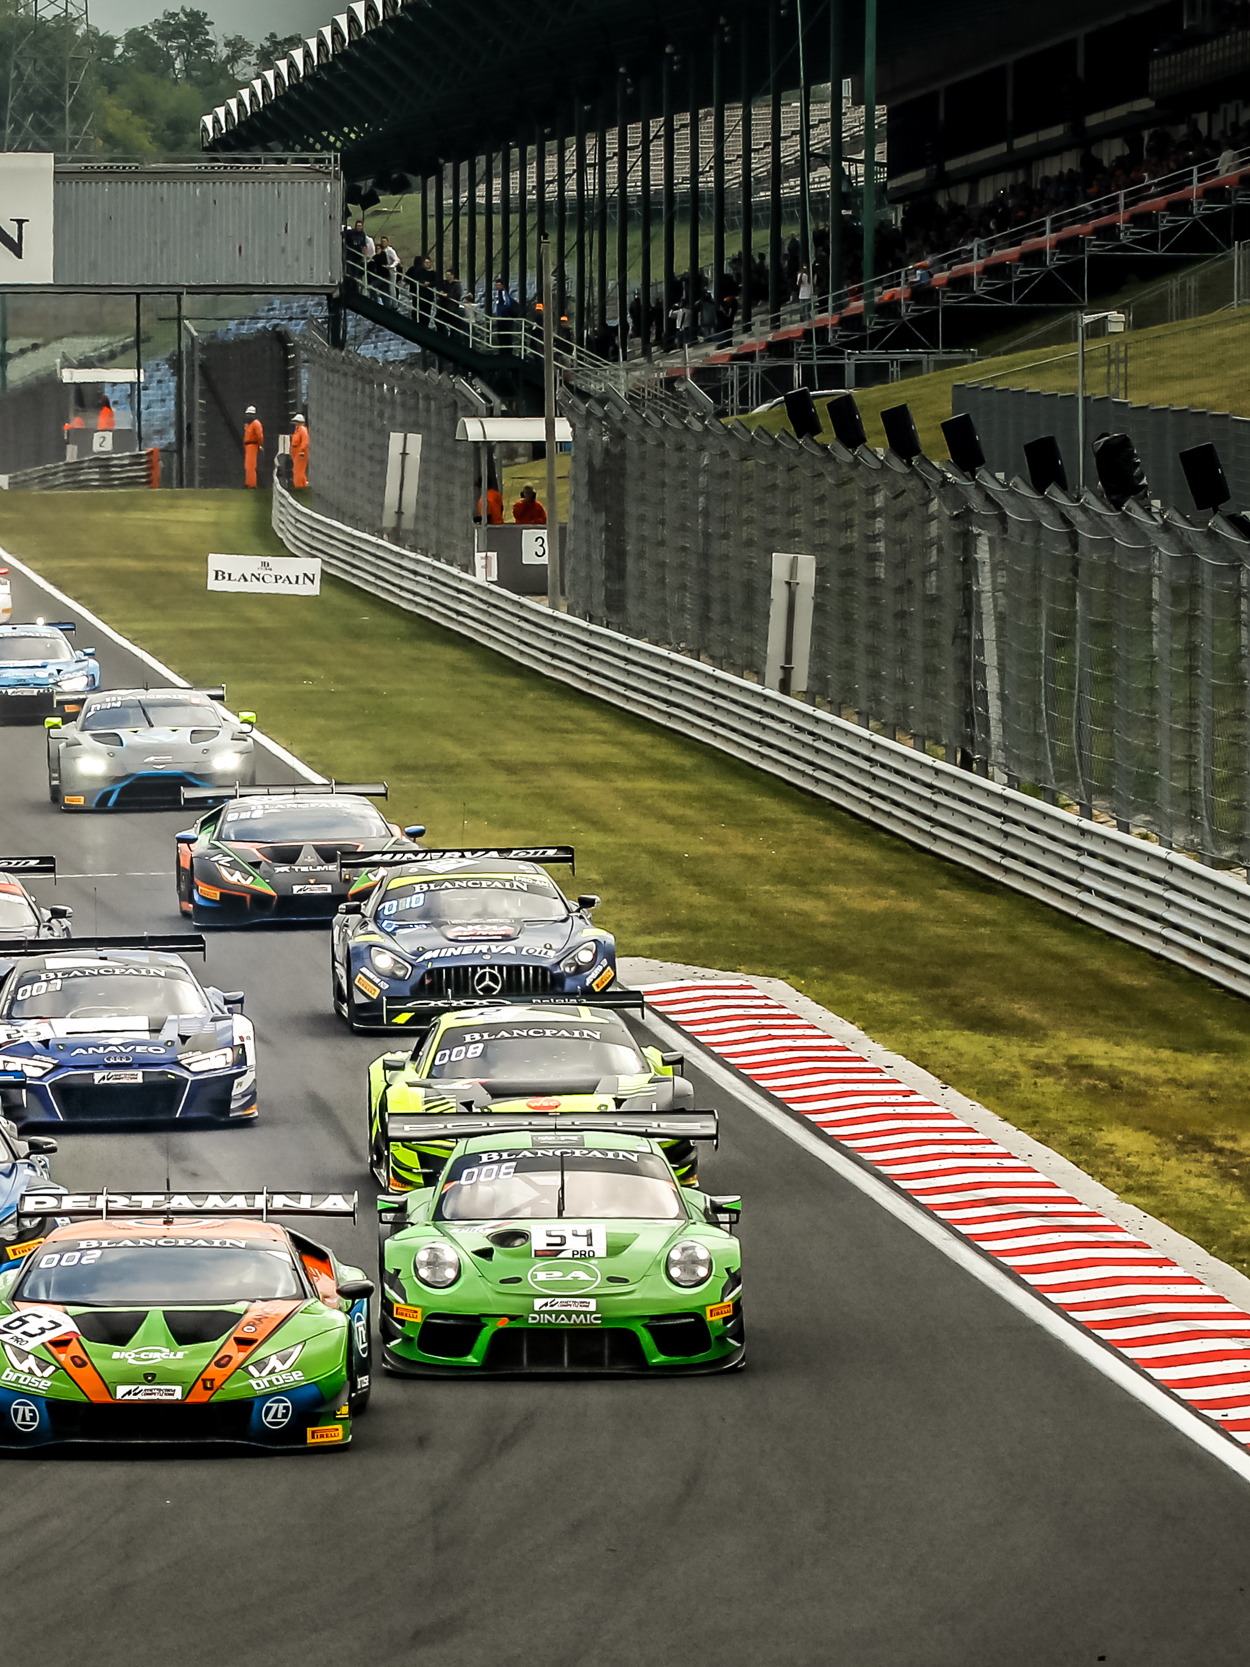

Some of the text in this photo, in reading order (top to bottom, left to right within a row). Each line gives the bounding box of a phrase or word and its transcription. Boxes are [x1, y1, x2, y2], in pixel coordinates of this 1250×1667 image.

[98, 434, 107, 448] 2
[535, 536, 546, 557] 3
[213, 569, 316, 585] BLANCPAIN
[413, 880, 528, 893] BLANCPAIN
[416, 945, 517, 962] MINERVA
[40, 968, 166, 980] BLANCPAIN
[17, 979, 63, 1001] 007
[4, 1027, 42, 1040] 25
[463, 1028, 602, 1044] BLANCPAIN
[70, 1045, 166, 1057] ANAVEO
[434, 1042, 485, 1066] 008
[479, 1149, 640, 1164] BLANCPAIN
[23, 1194, 354, 1212] PERTAMINA
[77, 1238, 248, 1250] BLANCPAIN
[545, 1228, 594, 1248] 54
[38, 1249, 103, 1269] 002
[572, 1249, 596, 1258] PRO
[533, 1270, 597, 1281] PA
[3, 1313, 62, 1338] 63
[527, 1313, 603, 1324] DINAMIC
[9, 1335, 29, 1346] PRO
[111, 1351, 185, 1359] BIO-CIRCLE
[1, 1368, 52, 1391] brose
[249, 1370, 305, 1391] brose
[310, 1427, 340, 1440] PIRELLI
